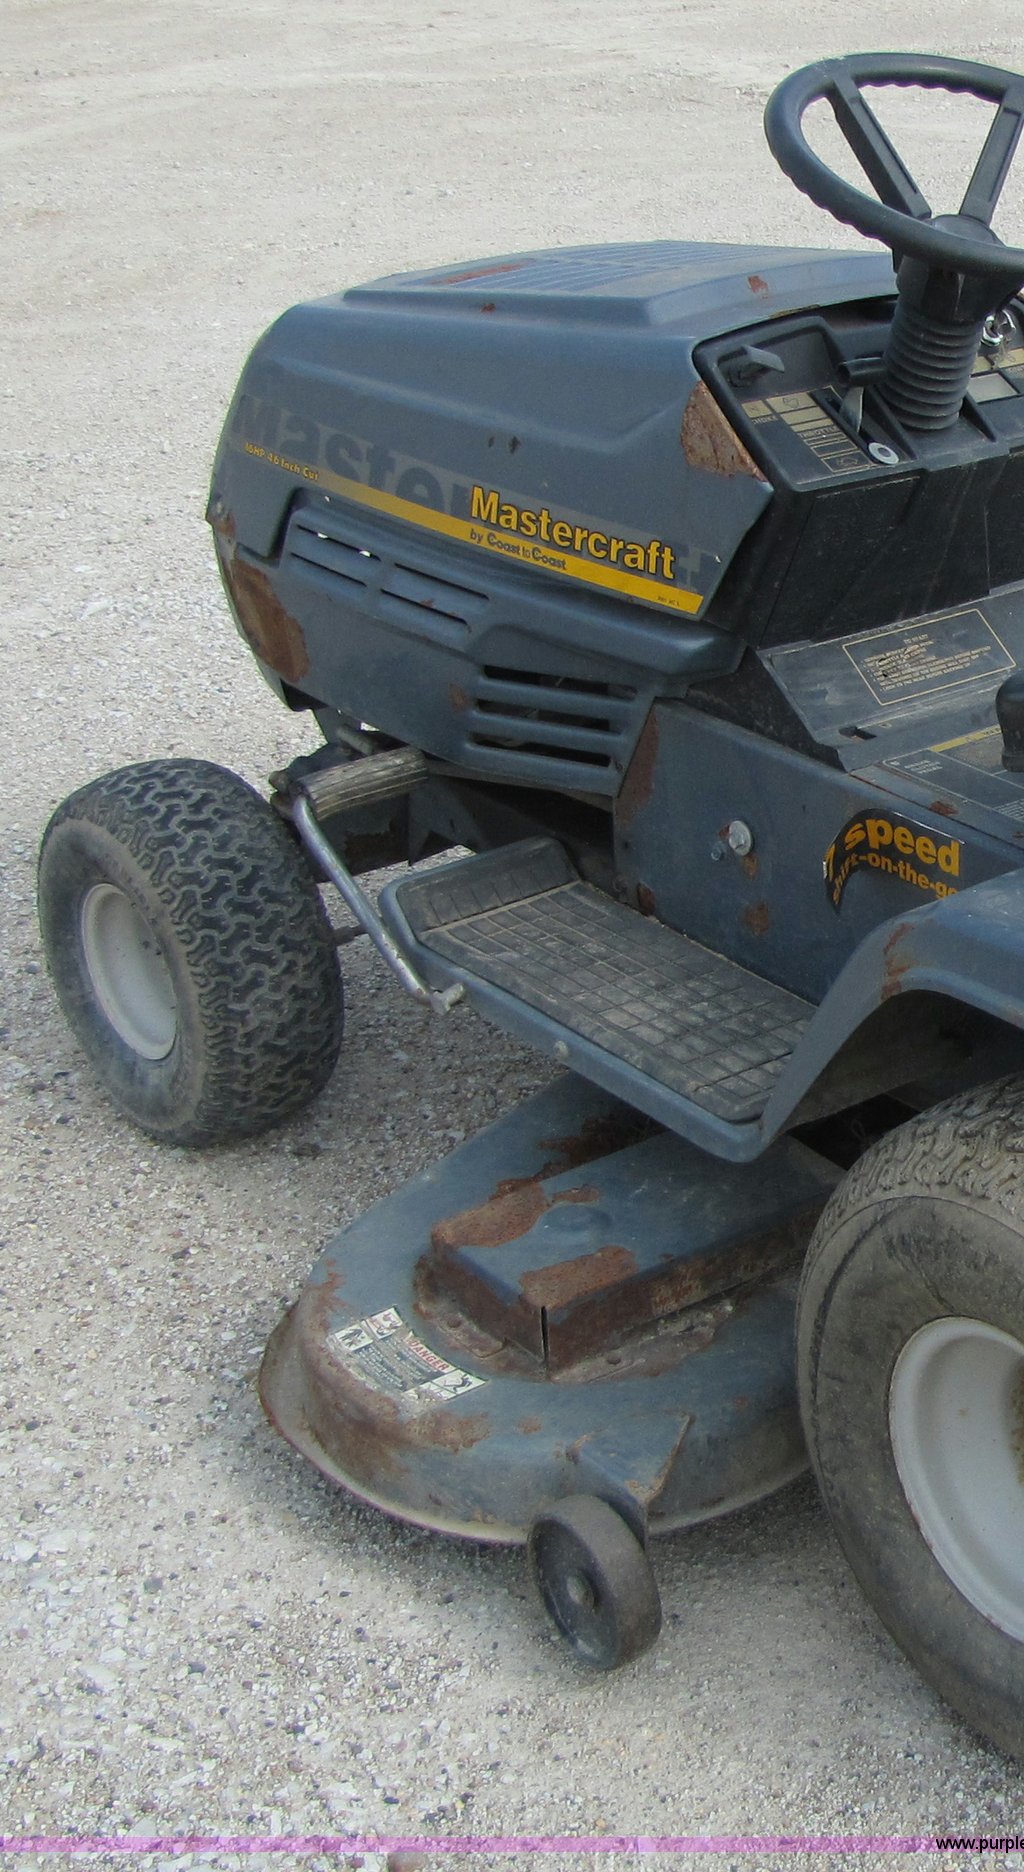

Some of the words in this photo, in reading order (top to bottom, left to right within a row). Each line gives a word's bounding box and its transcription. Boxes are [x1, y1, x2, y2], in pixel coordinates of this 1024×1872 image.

[470, 529, 484, 545] by
[487, 532, 521, 555] Coast
[531, 546, 567, 571] Coast
[471, 484, 676, 580] Mastercraft
[844, 818, 961, 877] speed
[408, 1338, 450, 1371] DANGER
